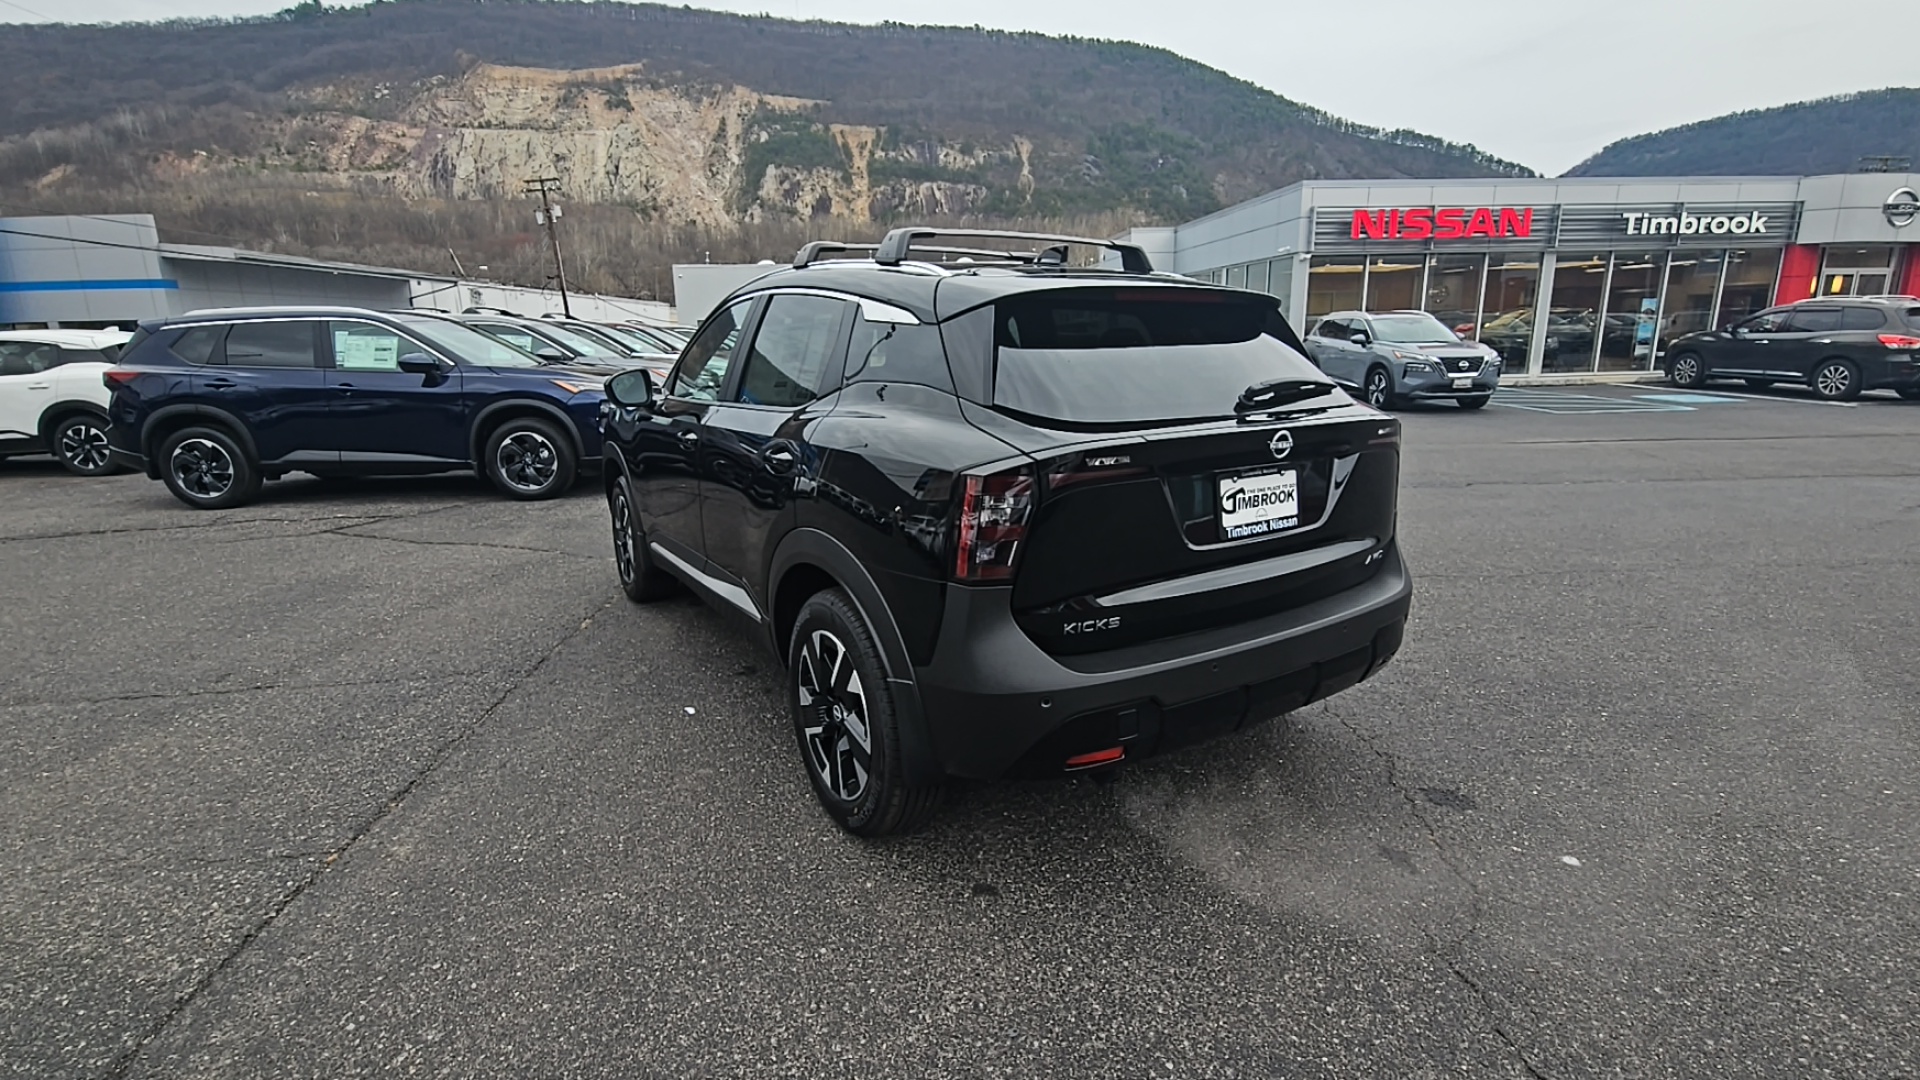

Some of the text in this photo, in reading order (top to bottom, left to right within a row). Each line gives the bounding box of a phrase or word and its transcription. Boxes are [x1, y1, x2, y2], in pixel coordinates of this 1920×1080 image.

[1351, 207, 1533, 240] NISSAN
[1622, 211, 1768, 235] Timbrook
[1226, 517, 1298, 538] Timbrook Nissan
[1063, 616, 1121, 635] KICKS
